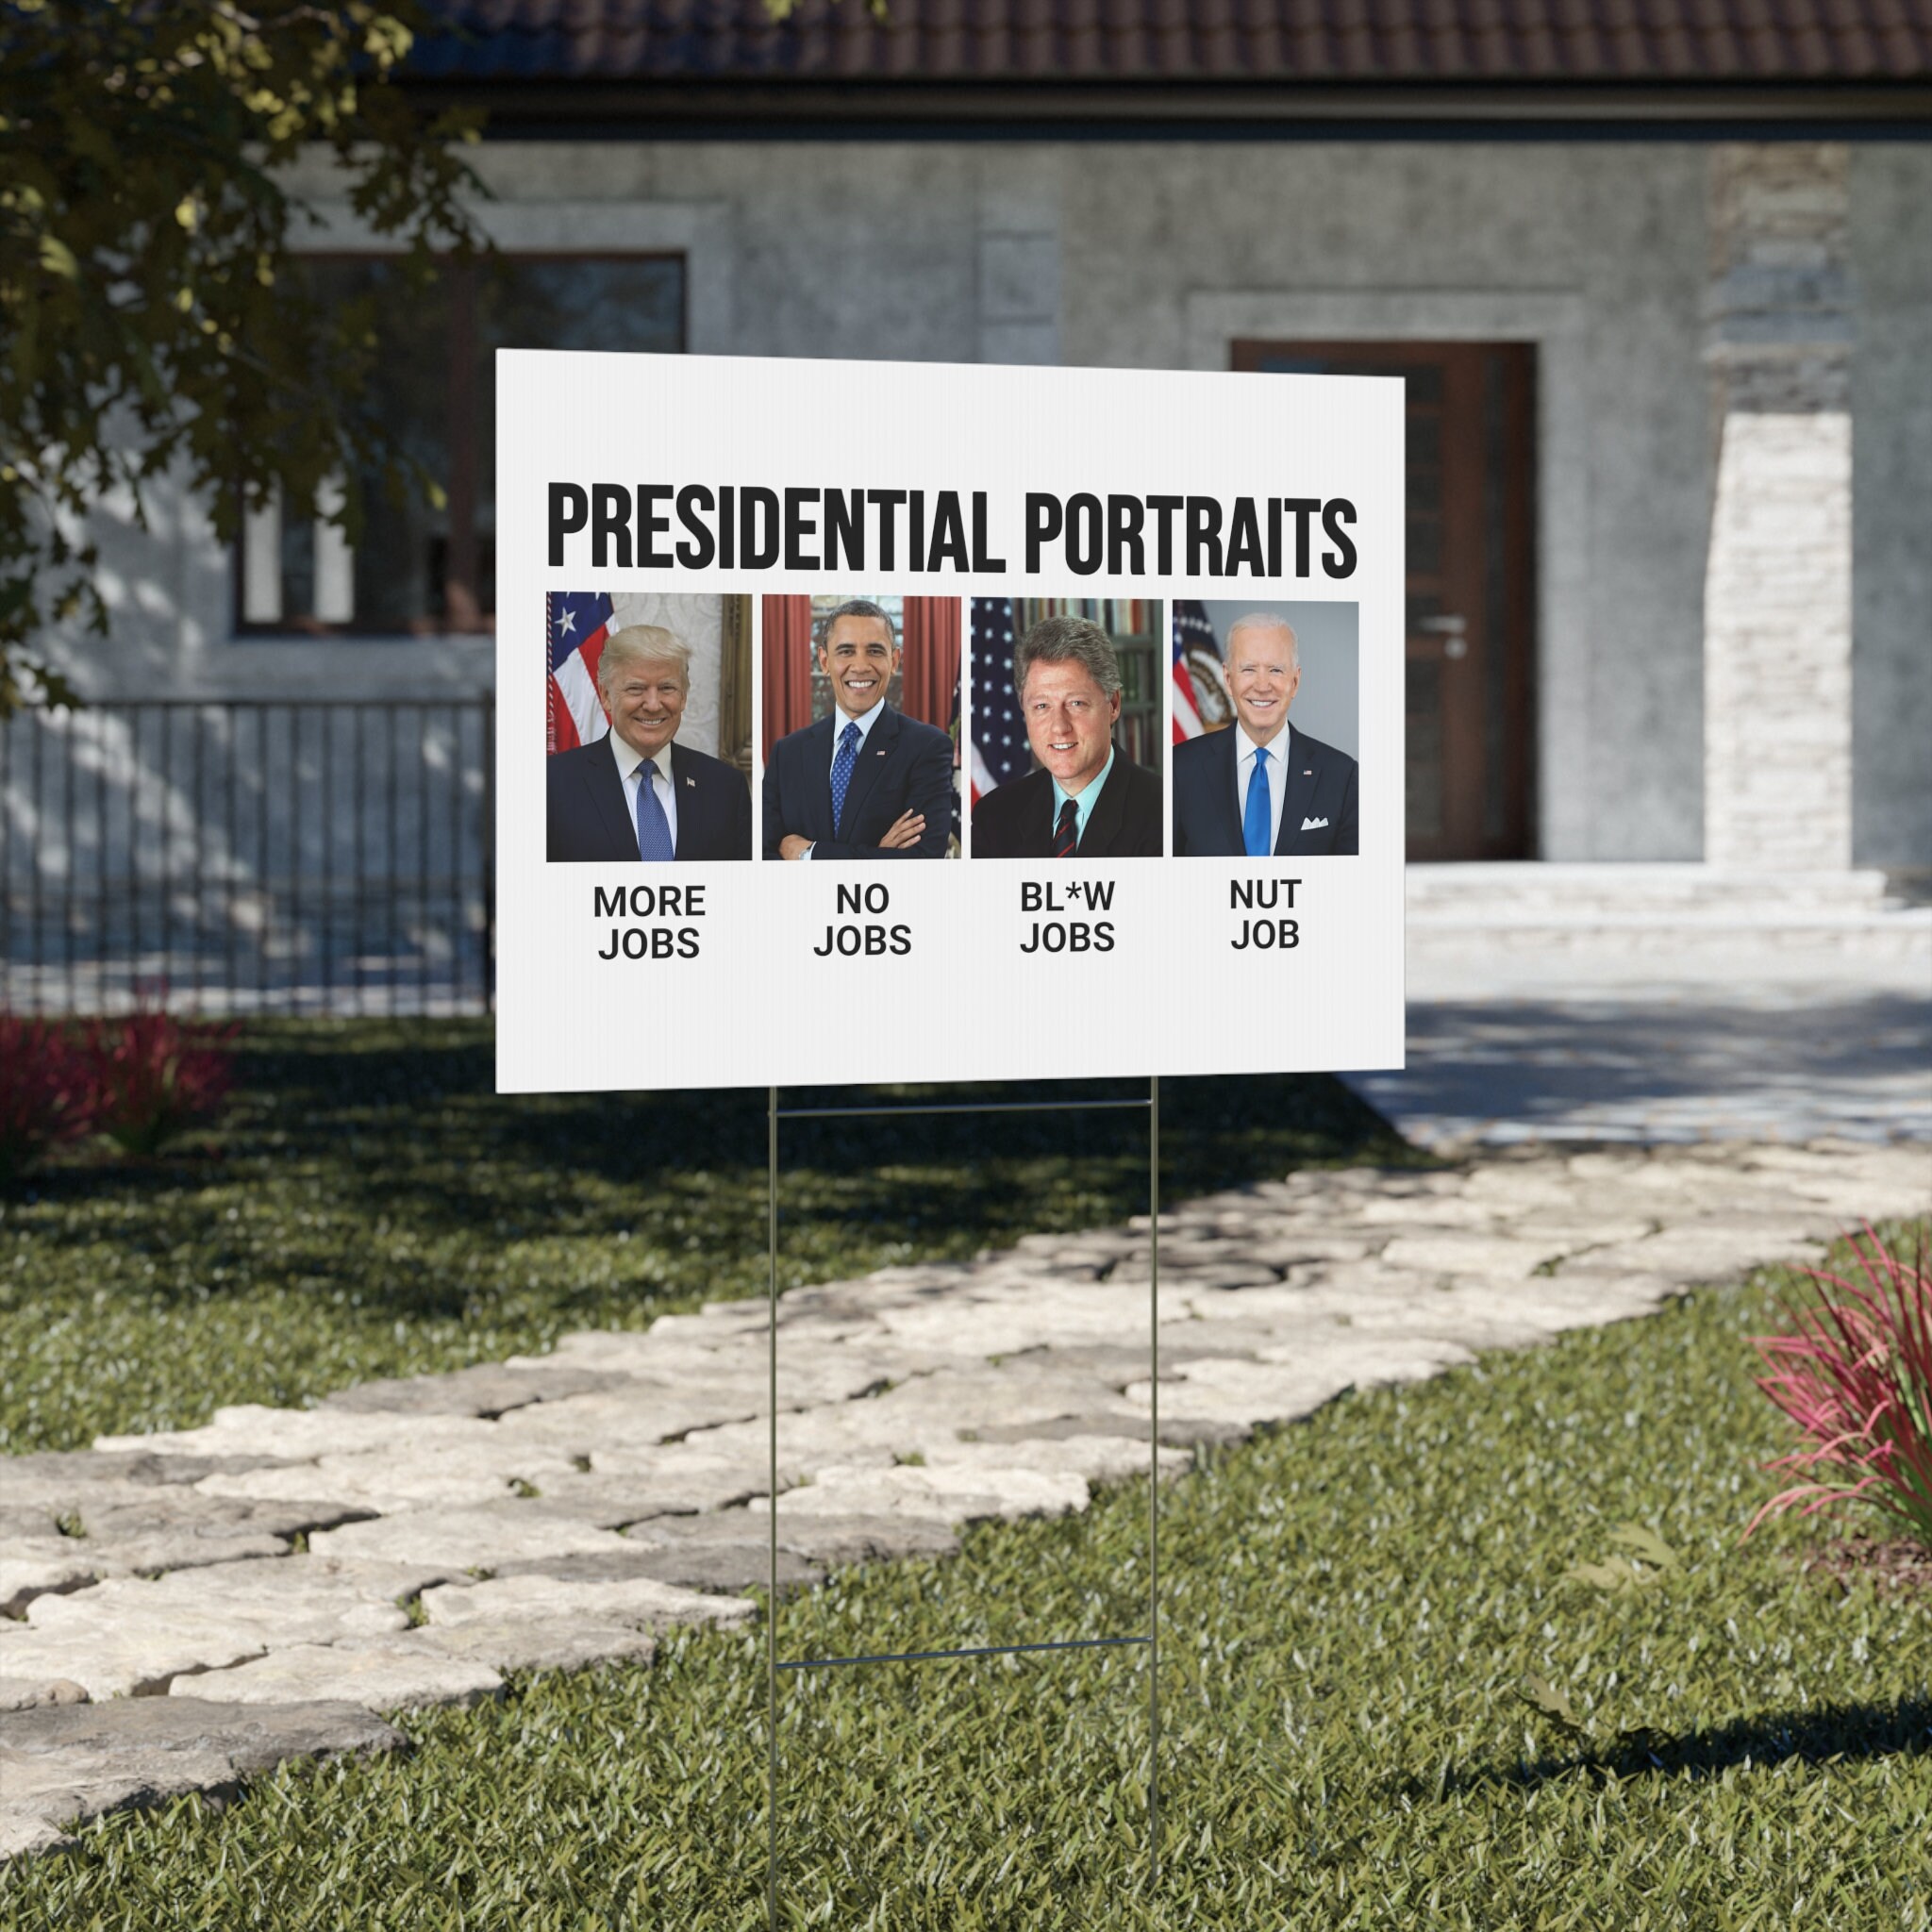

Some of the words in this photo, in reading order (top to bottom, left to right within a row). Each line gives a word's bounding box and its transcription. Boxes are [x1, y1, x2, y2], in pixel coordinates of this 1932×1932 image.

[548, 481, 1007, 574] PRESIDENTIAL
[1025, 491, 1357, 579] PORTRAITS
[594, 885, 706, 918] MORE
[837, 883, 890, 914] NO
[1230, 878, 1303, 909] NUT
[598, 926, 700, 960] JOBS
[813, 924, 911, 957] JOBS
[1020, 921, 1115, 954] JOBS
[1230, 919, 1300, 950] JOB
